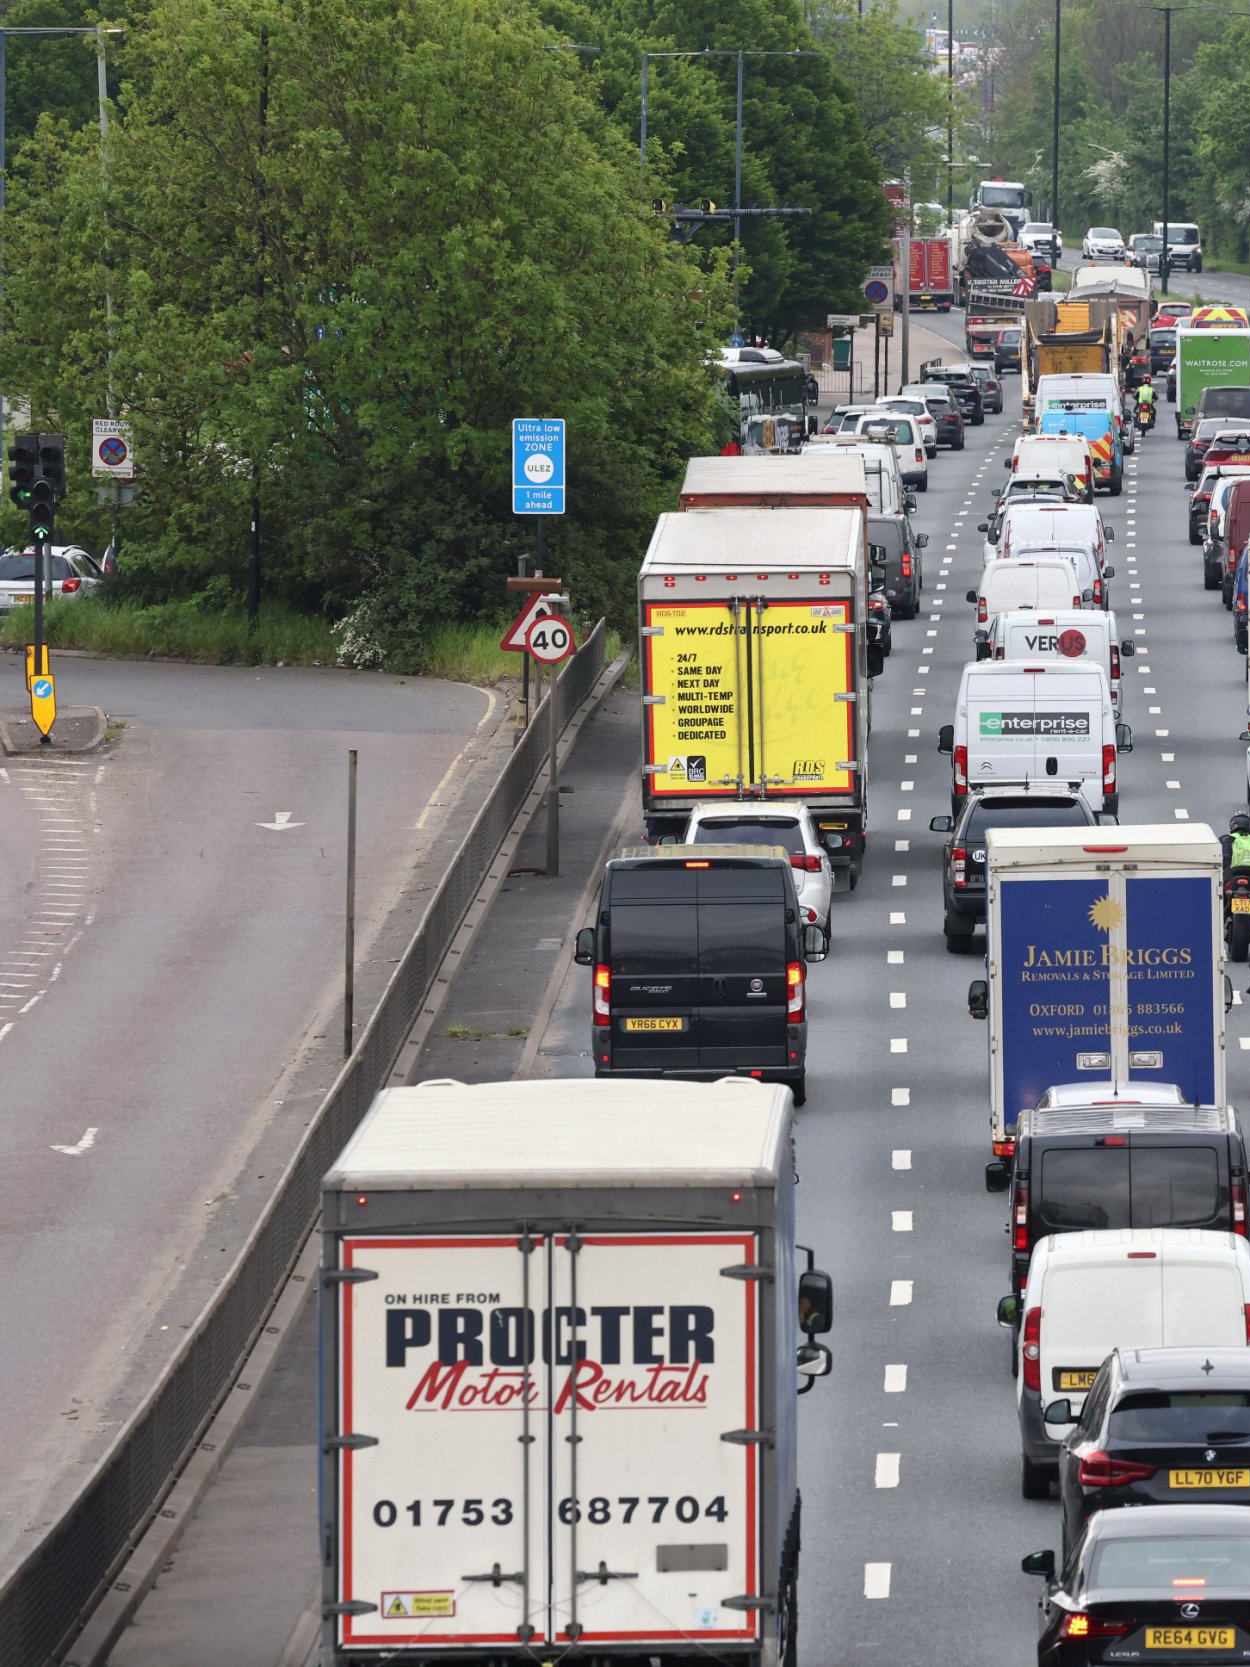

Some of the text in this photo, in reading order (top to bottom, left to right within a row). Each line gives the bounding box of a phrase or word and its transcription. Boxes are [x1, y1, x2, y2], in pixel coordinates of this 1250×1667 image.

[518, 424, 560, 432] Ultra low
[520, 434, 559, 442] emission
[526, 490, 552, 499] 1 mile
[526, 501, 552, 509] ahead
[676, 620, 827, 637] www.rdstransport.co.uk
[533, 629, 567, 650] 40
[1024, 636, 1084, 651] VERUS
[678, 654, 697, 663] 24/7
[678, 666, 722, 675] SAME DAY
[678, 679, 720, 688] NEXT DAY
[678, 692, 733, 701] MULTI-TEMP
[678, 704, 734, 714] WORLDWIDE
[678, 718, 724, 727] GROUPAGE
[984, 716, 1088, 732] enterprise
[678, 730, 726, 740] DEDICATED
[1024, 944, 1192, 967] JAMIE BRIGGS
[1022, 972, 1080, 982] REMOVALS
[1082, 972, 1090, 981] &
[1148, 969, 1195, 979] LIMITED
[1030, 1004, 1084, 1017] OXFORD
[1137, 1004, 1185, 1015] 883566
[631, 1020, 679, 1029] YR66 CYX
[1033, 1022, 1182, 1039] www.jamiebriggs.co.uk
[385, 1293, 500, 1304] ON HIRE FROM
[386, 1306, 715, 1367] PROCTER
[405, 1360, 709, 1414] Motor Rentals
[1176, 1471, 1244, 1485] LL70 YGF
[374, 1496, 728, 1527] 01753 687704
[1152, 1630, 1228, 1645] RE64 GVG
